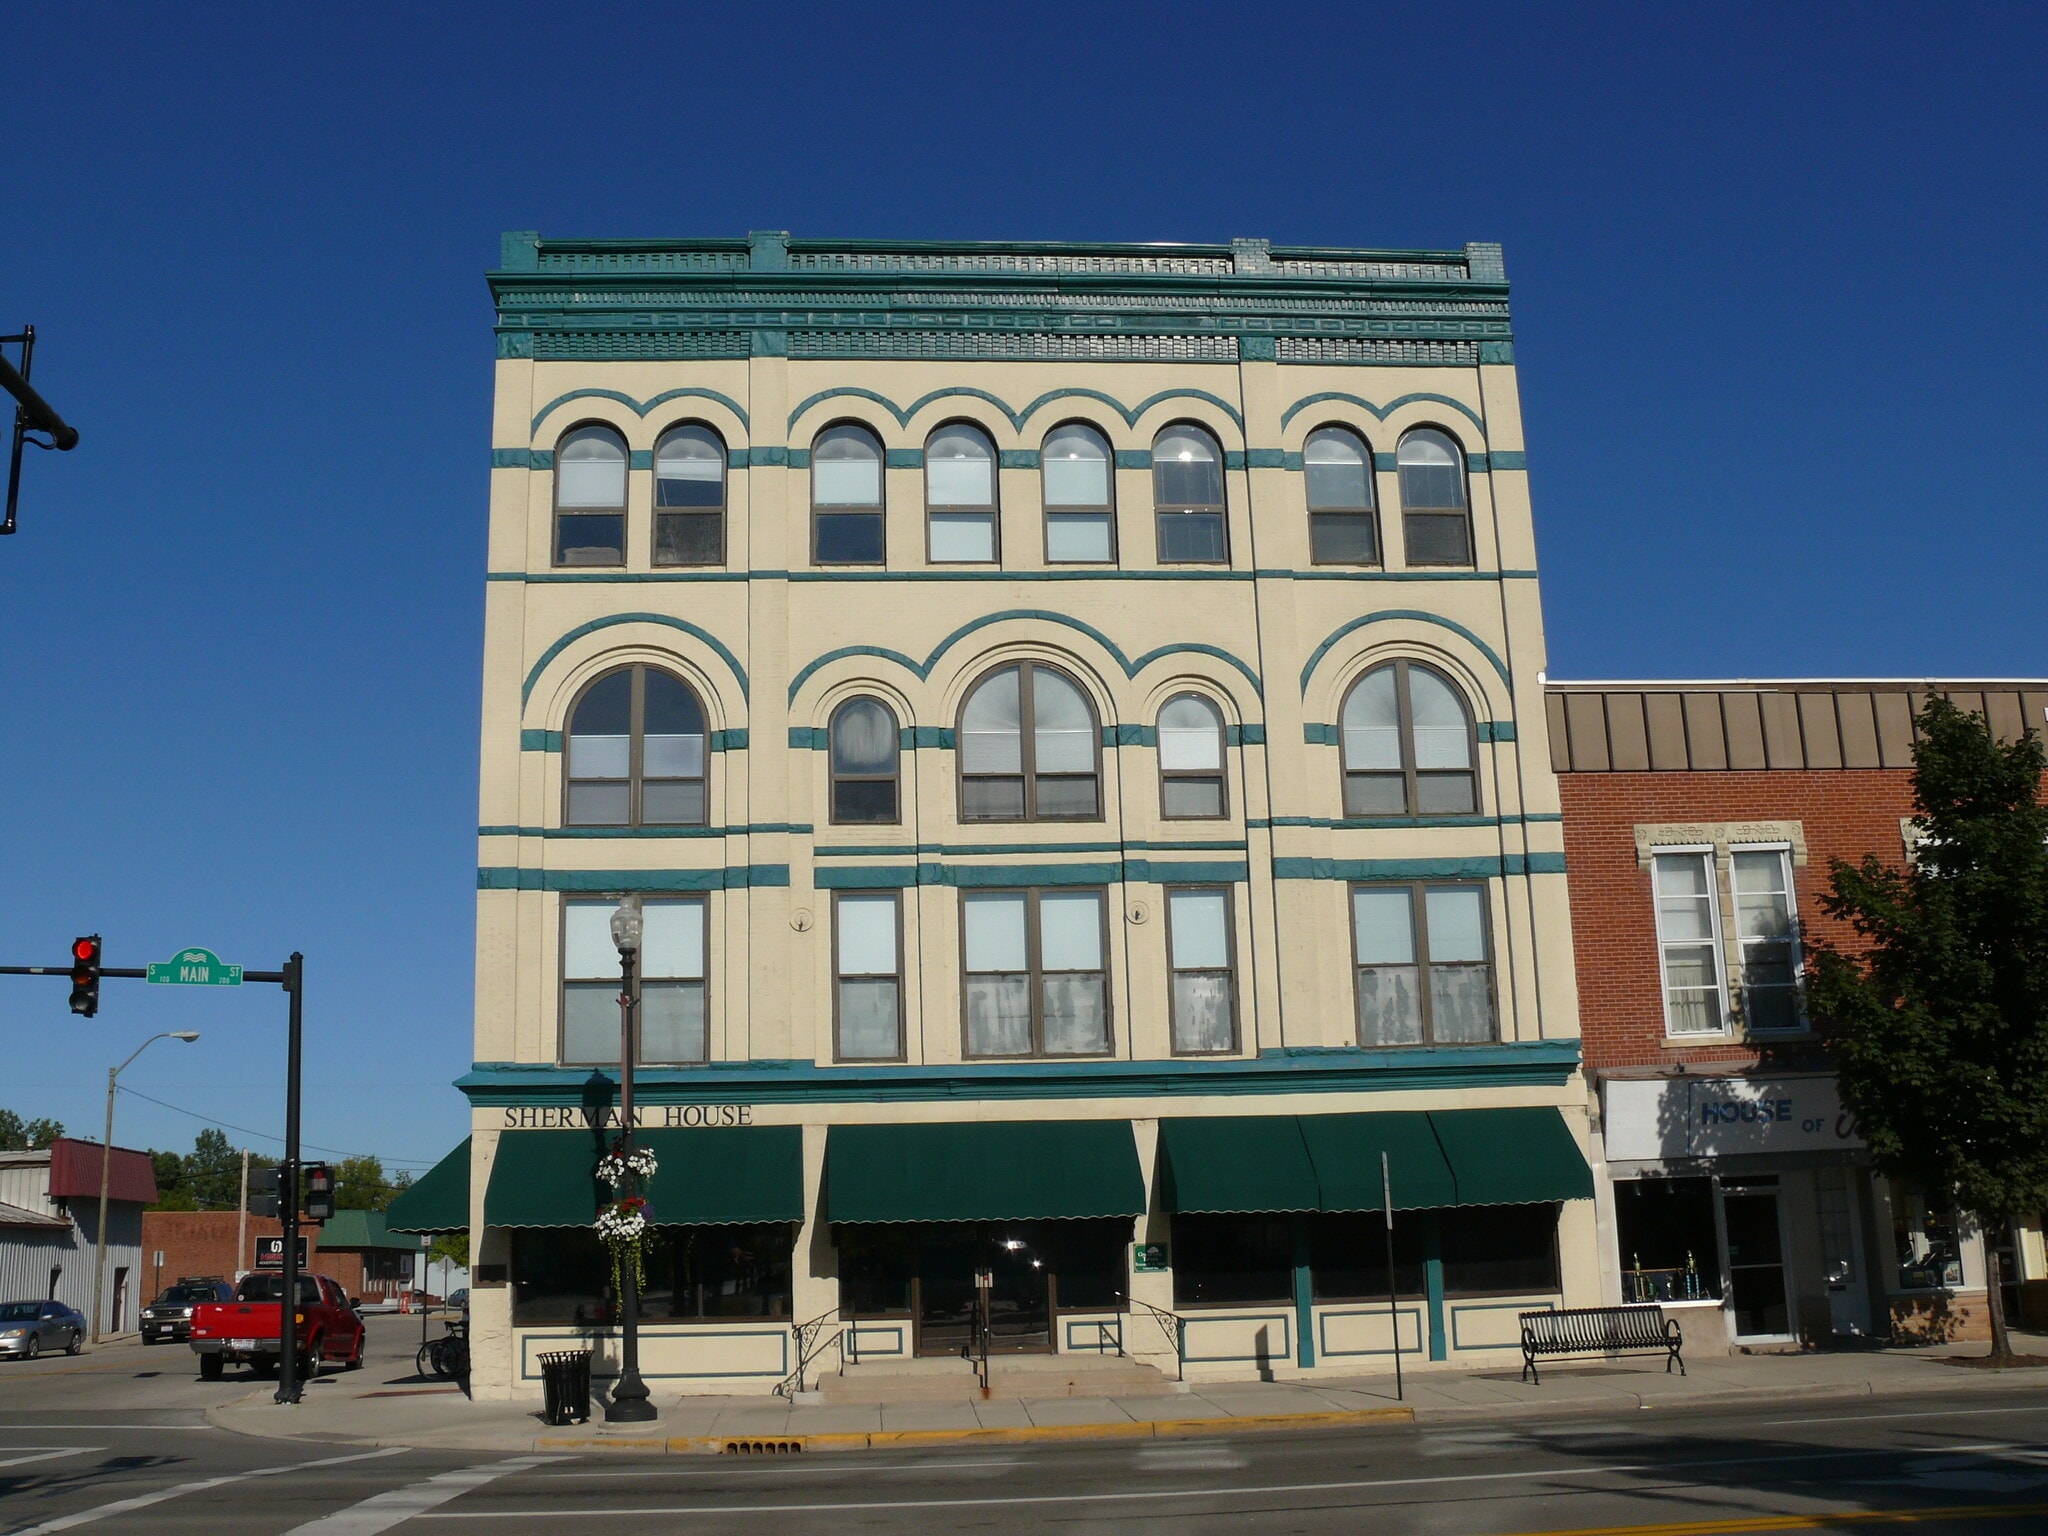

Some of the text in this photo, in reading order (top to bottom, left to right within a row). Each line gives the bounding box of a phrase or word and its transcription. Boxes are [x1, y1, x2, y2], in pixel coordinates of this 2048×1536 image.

[150, 965, 240, 982] S MAIN ST
[504, 1105, 753, 1128] SHERMAN HOUSE
[1701, 1099, 1792, 1125] HOUSE
[1802, 1119, 1825, 1133] OF
